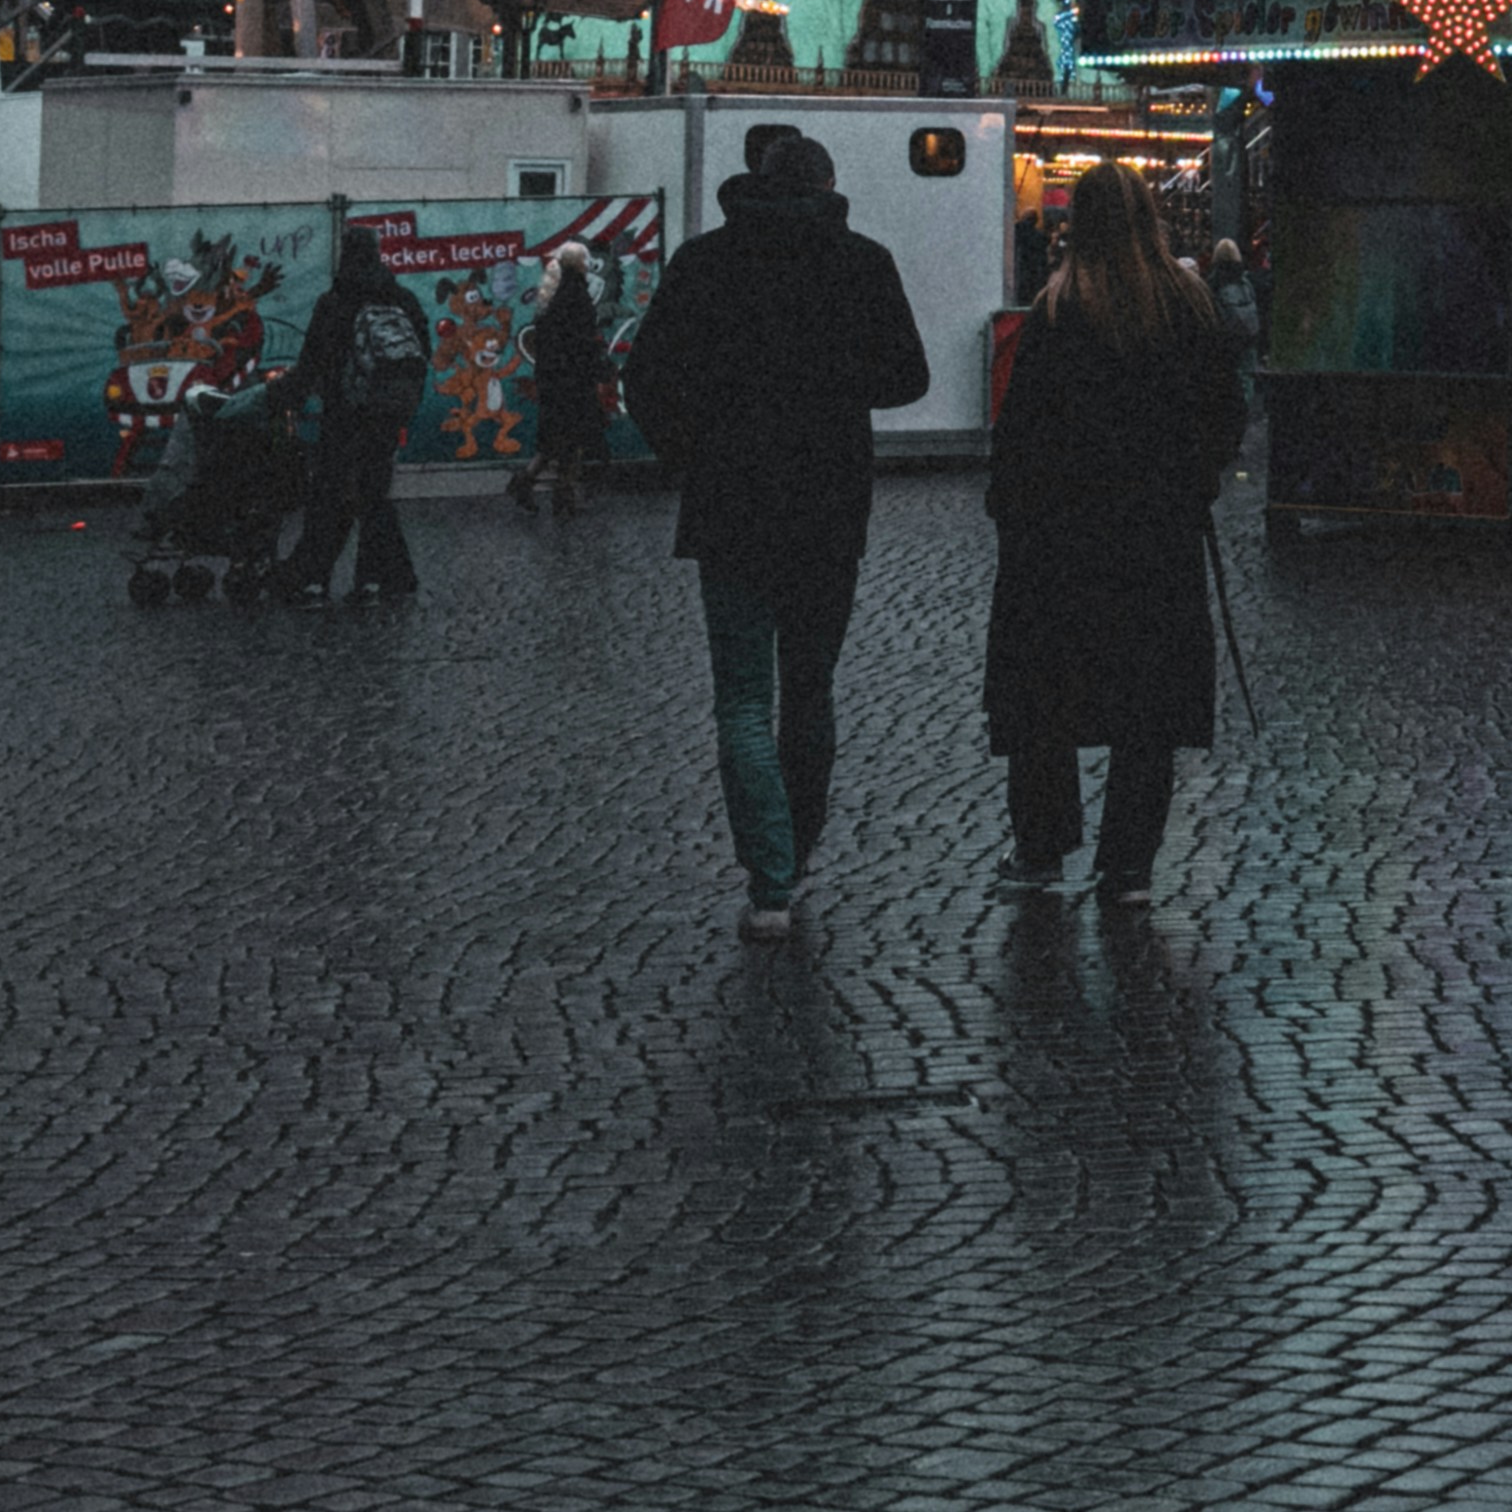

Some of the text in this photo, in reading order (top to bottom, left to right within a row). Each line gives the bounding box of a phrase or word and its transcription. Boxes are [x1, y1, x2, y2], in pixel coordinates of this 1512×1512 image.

[8, 228, 69, 254] Ischa
[379, 241, 518, 268] ecker, lecker
[28, 248, 148, 281] volle Pulle
